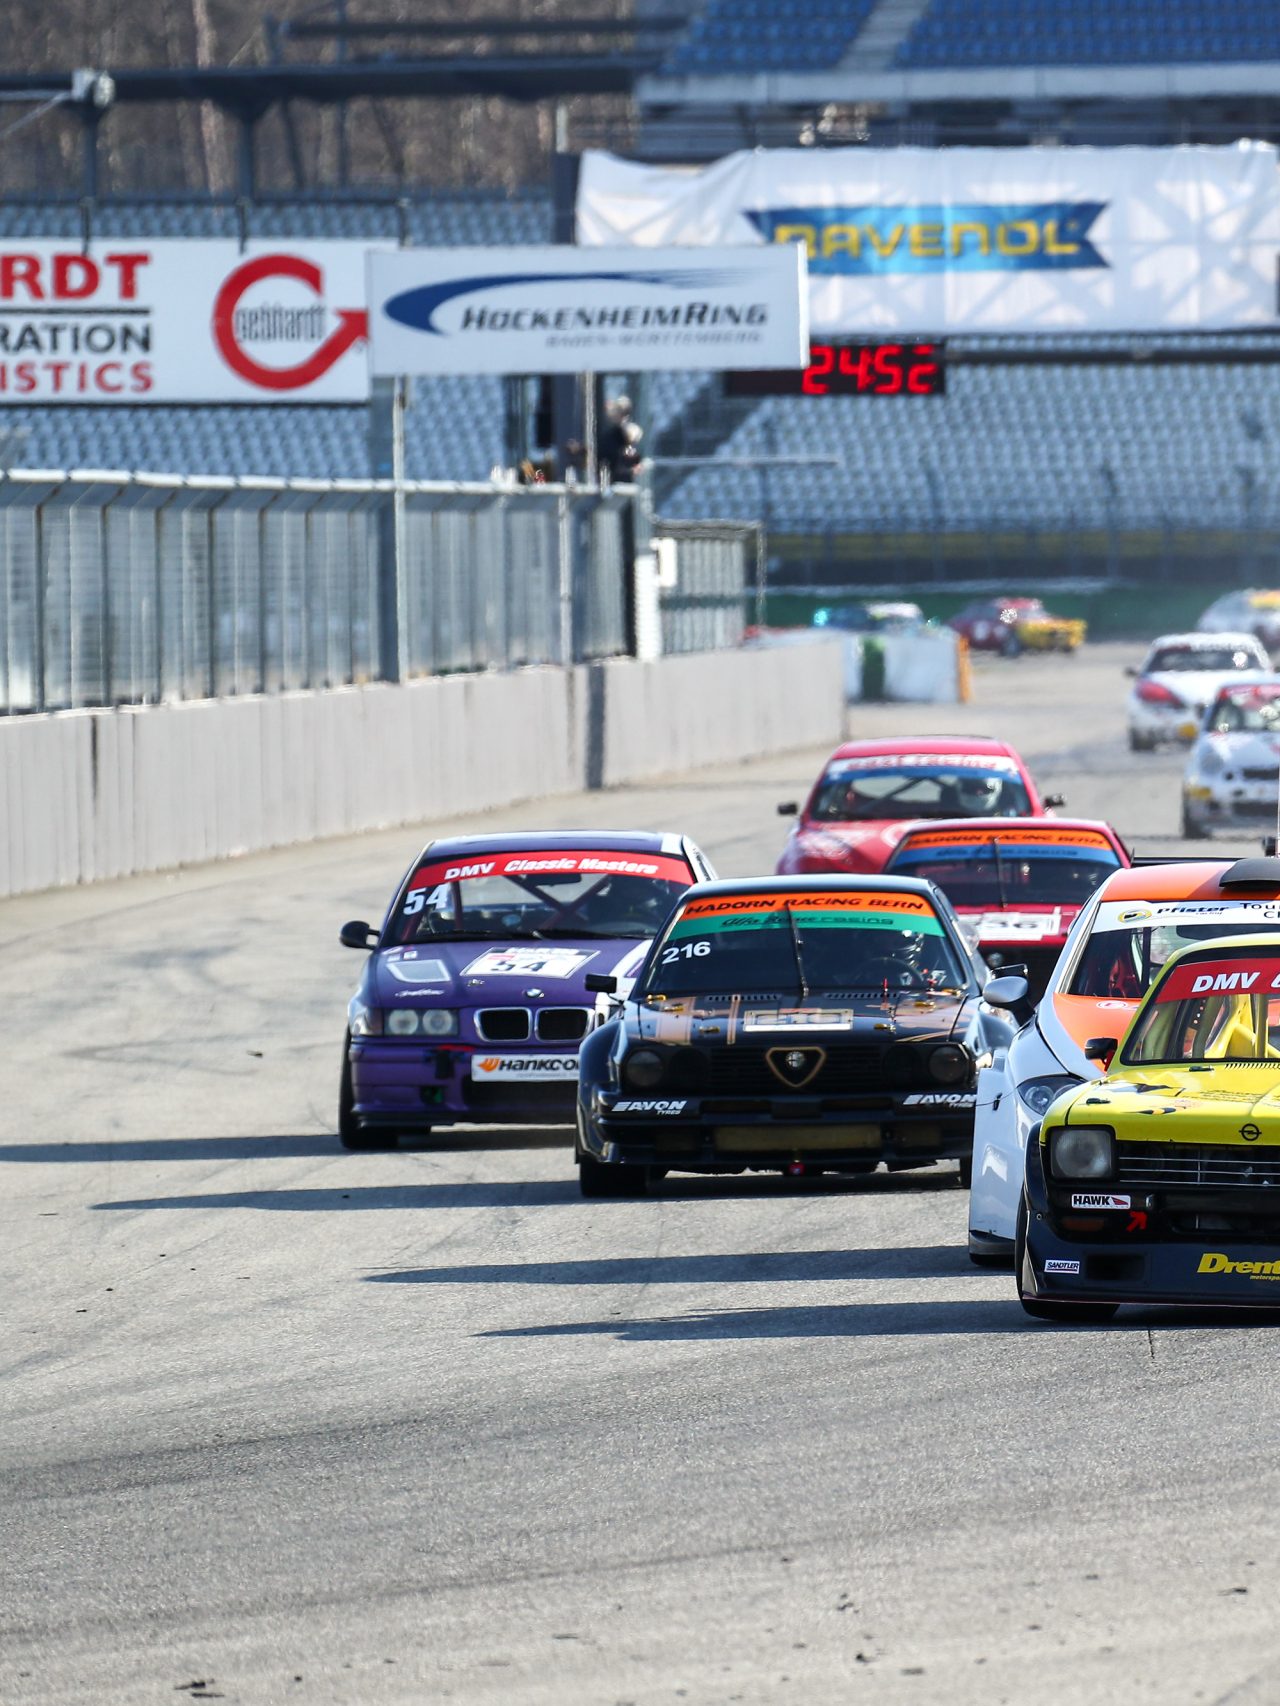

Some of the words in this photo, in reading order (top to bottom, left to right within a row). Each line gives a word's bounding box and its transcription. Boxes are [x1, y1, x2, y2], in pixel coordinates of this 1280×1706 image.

[0, 253, 150, 300] RDT
[444, 861, 497, 881] DMV
[503, 857, 577, 873] Classic
[577, 858, 660, 875] Masters
[402, 883, 449, 916] 54
[684, 899, 777, 915] HADORN
[785, 897, 863, 907] RACING
[867, 899, 925, 909] BERN
[661, 941, 711, 965] 216
[1191, 972, 1261, 993] DMV
[627, 1100, 688, 1111] AVON
[919, 1094, 977, 1103] AVON
[1073, 1195, 1113, 1206] HAWK
[1047, 1261, 1080, 1270] SANDTLER
